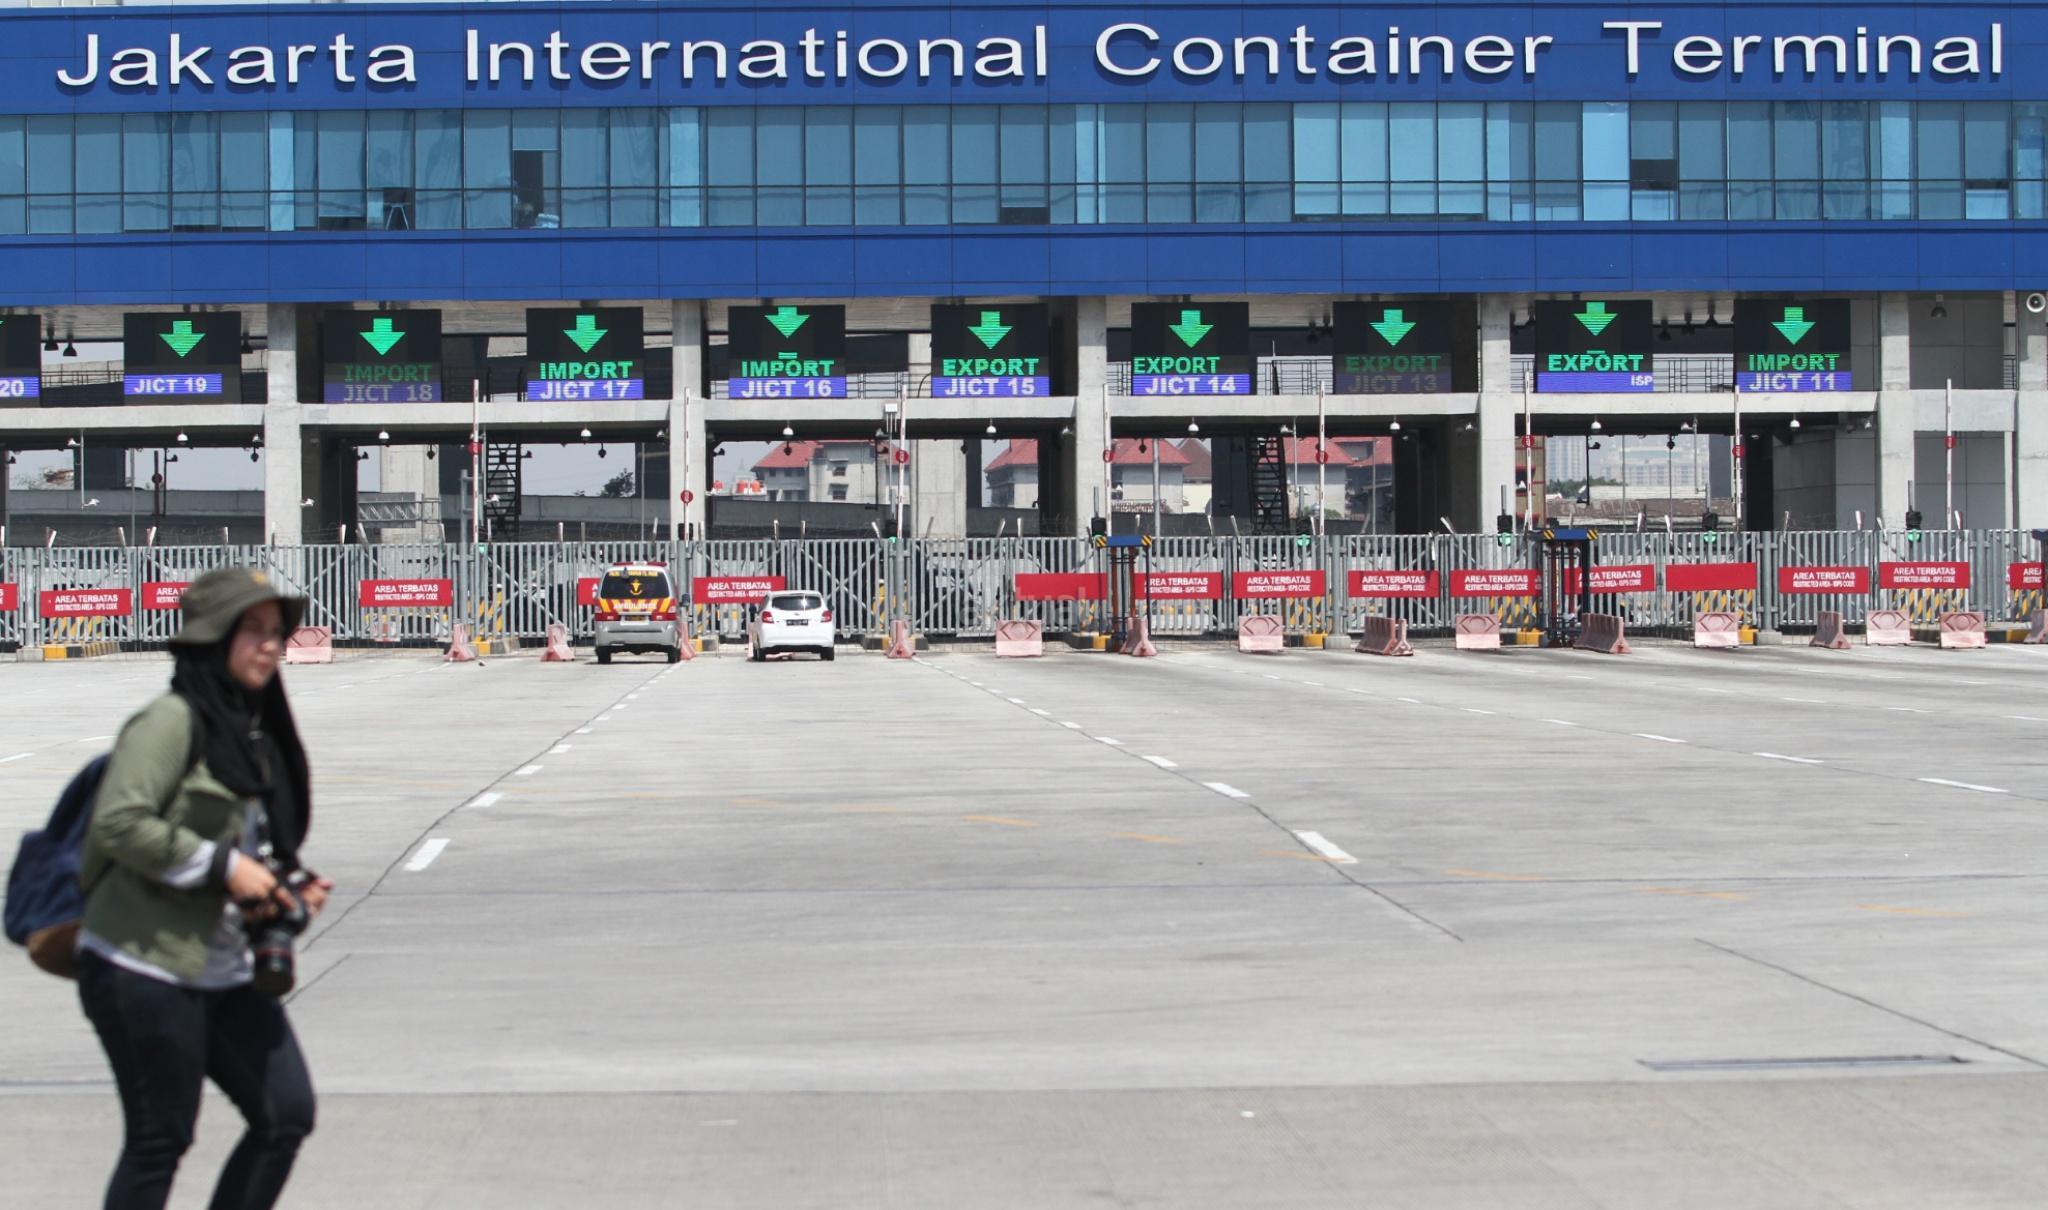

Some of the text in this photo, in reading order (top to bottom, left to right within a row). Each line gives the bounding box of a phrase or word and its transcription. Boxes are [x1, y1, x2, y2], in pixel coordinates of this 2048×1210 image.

[57, 21, 2001, 87] Jakarta International Container Terminal
[540, 361, 633, 380] IMPORT
[741, 359, 835, 377] IMPORT
[942, 358, 1039, 376] EXPORT
[1133, 356, 1221, 374] EXPORT
[1345, 355, 1441, 373] EXPORT
[1548, 354, 1644, 372] EXPORT
[1748, 353, 1840, 371] IMPORT
[344, 364, 433, 382] IMPORT
[1631, 375, 1652, 386] ISP
[1749, 372, 1835, 390] JICT 11
[0, 380, 25, 397] 20
[134, 377, 207, 393] JICT 19
[540, 380, 630, 399] JICT 17
[741, 380, 832, 398] JICT 16
[944, 377, 1035, 395] JICT 15
[1145, 376, 1236, 394] JICT 14
[1348, 374, 1437, 392] JICT 13
[343, 384, 433, 402] JICT 18
[1270, 575, 1311, 584] TERBATAS
[1362, 575, 1426, 583] AREA TERBATAS
[1601, 570, 1642, 579] TERBATAS
[1793, 572, 1856, 580] AREA TERBATAS
[1893, 567, 1956, 575] AREA TERBATAS
[398, 584, 438, 592] TERBATAS
[707, 582, 730, 590] AREA
[1144, 577, 1208, 586] REA TERBATAS
[55, 594, 118, 603] AREA TERBATAS
[156, 587, 179, 596] AREA
